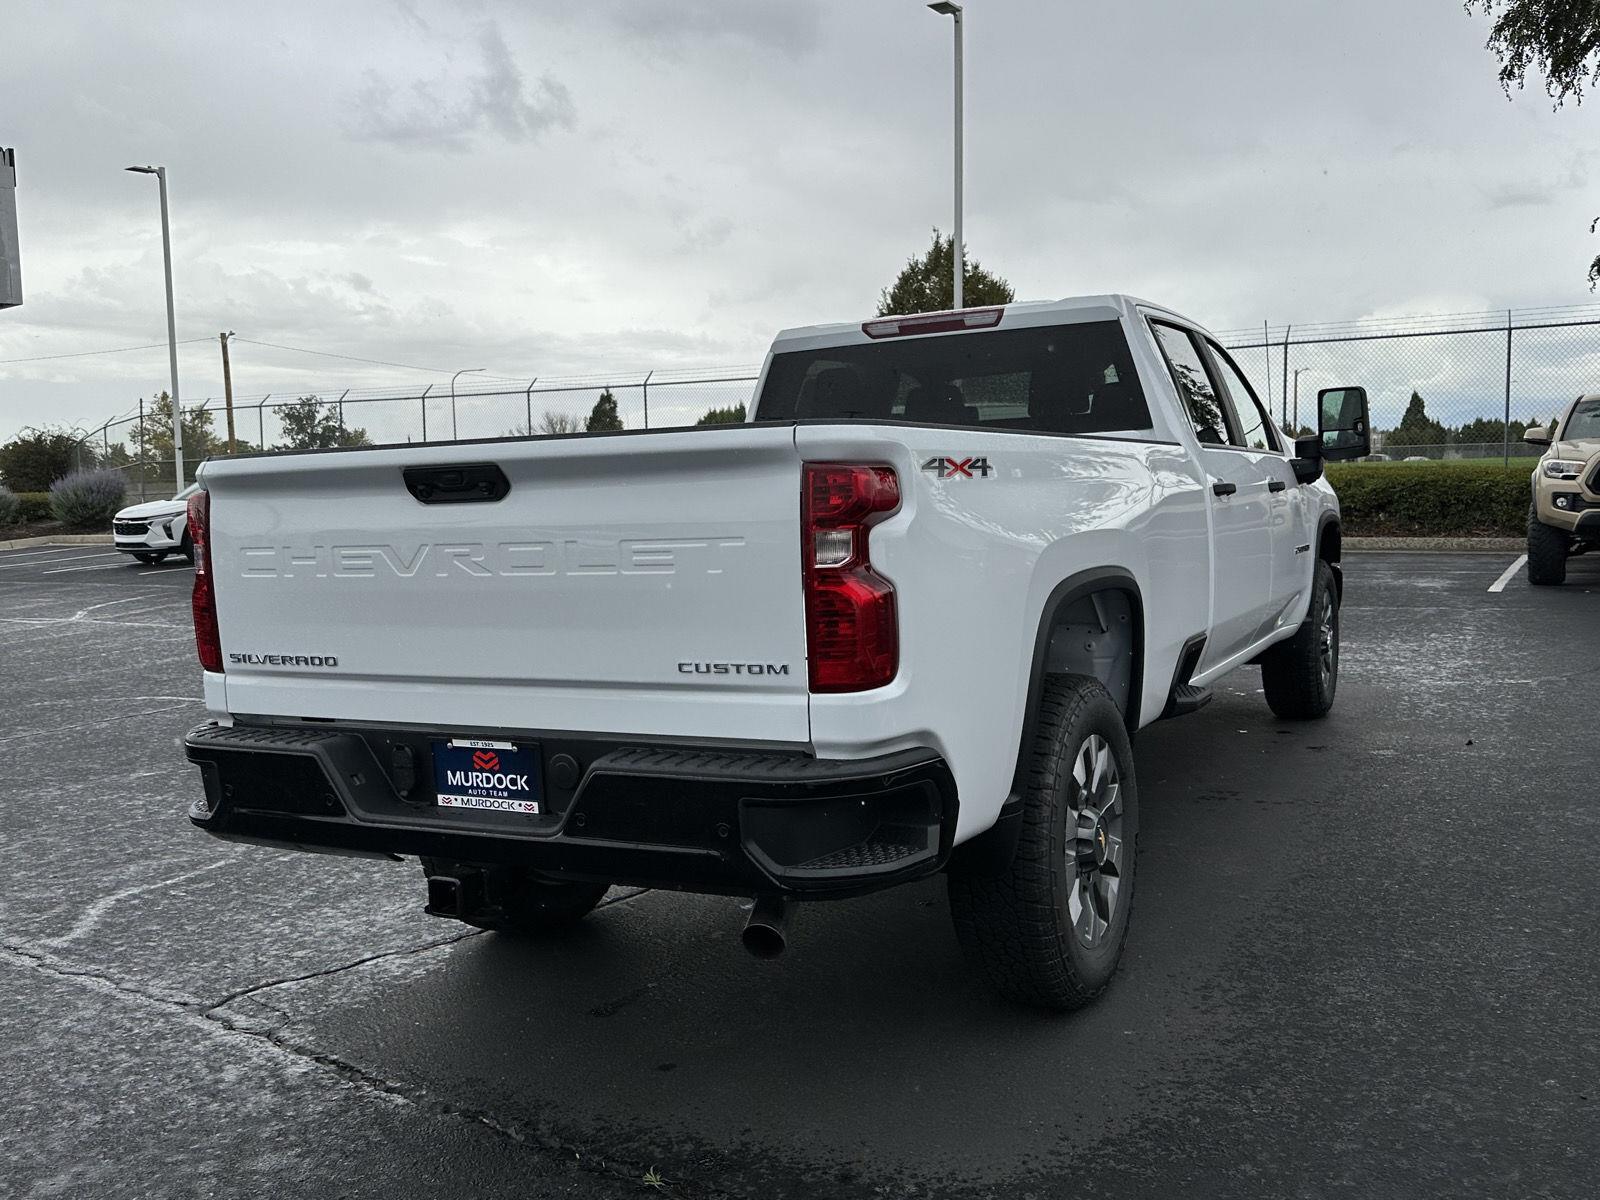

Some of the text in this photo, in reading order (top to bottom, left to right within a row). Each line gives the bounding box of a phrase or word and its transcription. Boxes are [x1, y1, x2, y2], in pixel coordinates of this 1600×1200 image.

[239, 537, 745, 576] CHEVROLET
[229, 653, 338, 667] SILVERADO
[677, 662, 790, 675] CUSTOM
[446, 770, 530, 791] MURDOCK
[460, 798, 516, 810] MURDOCK
